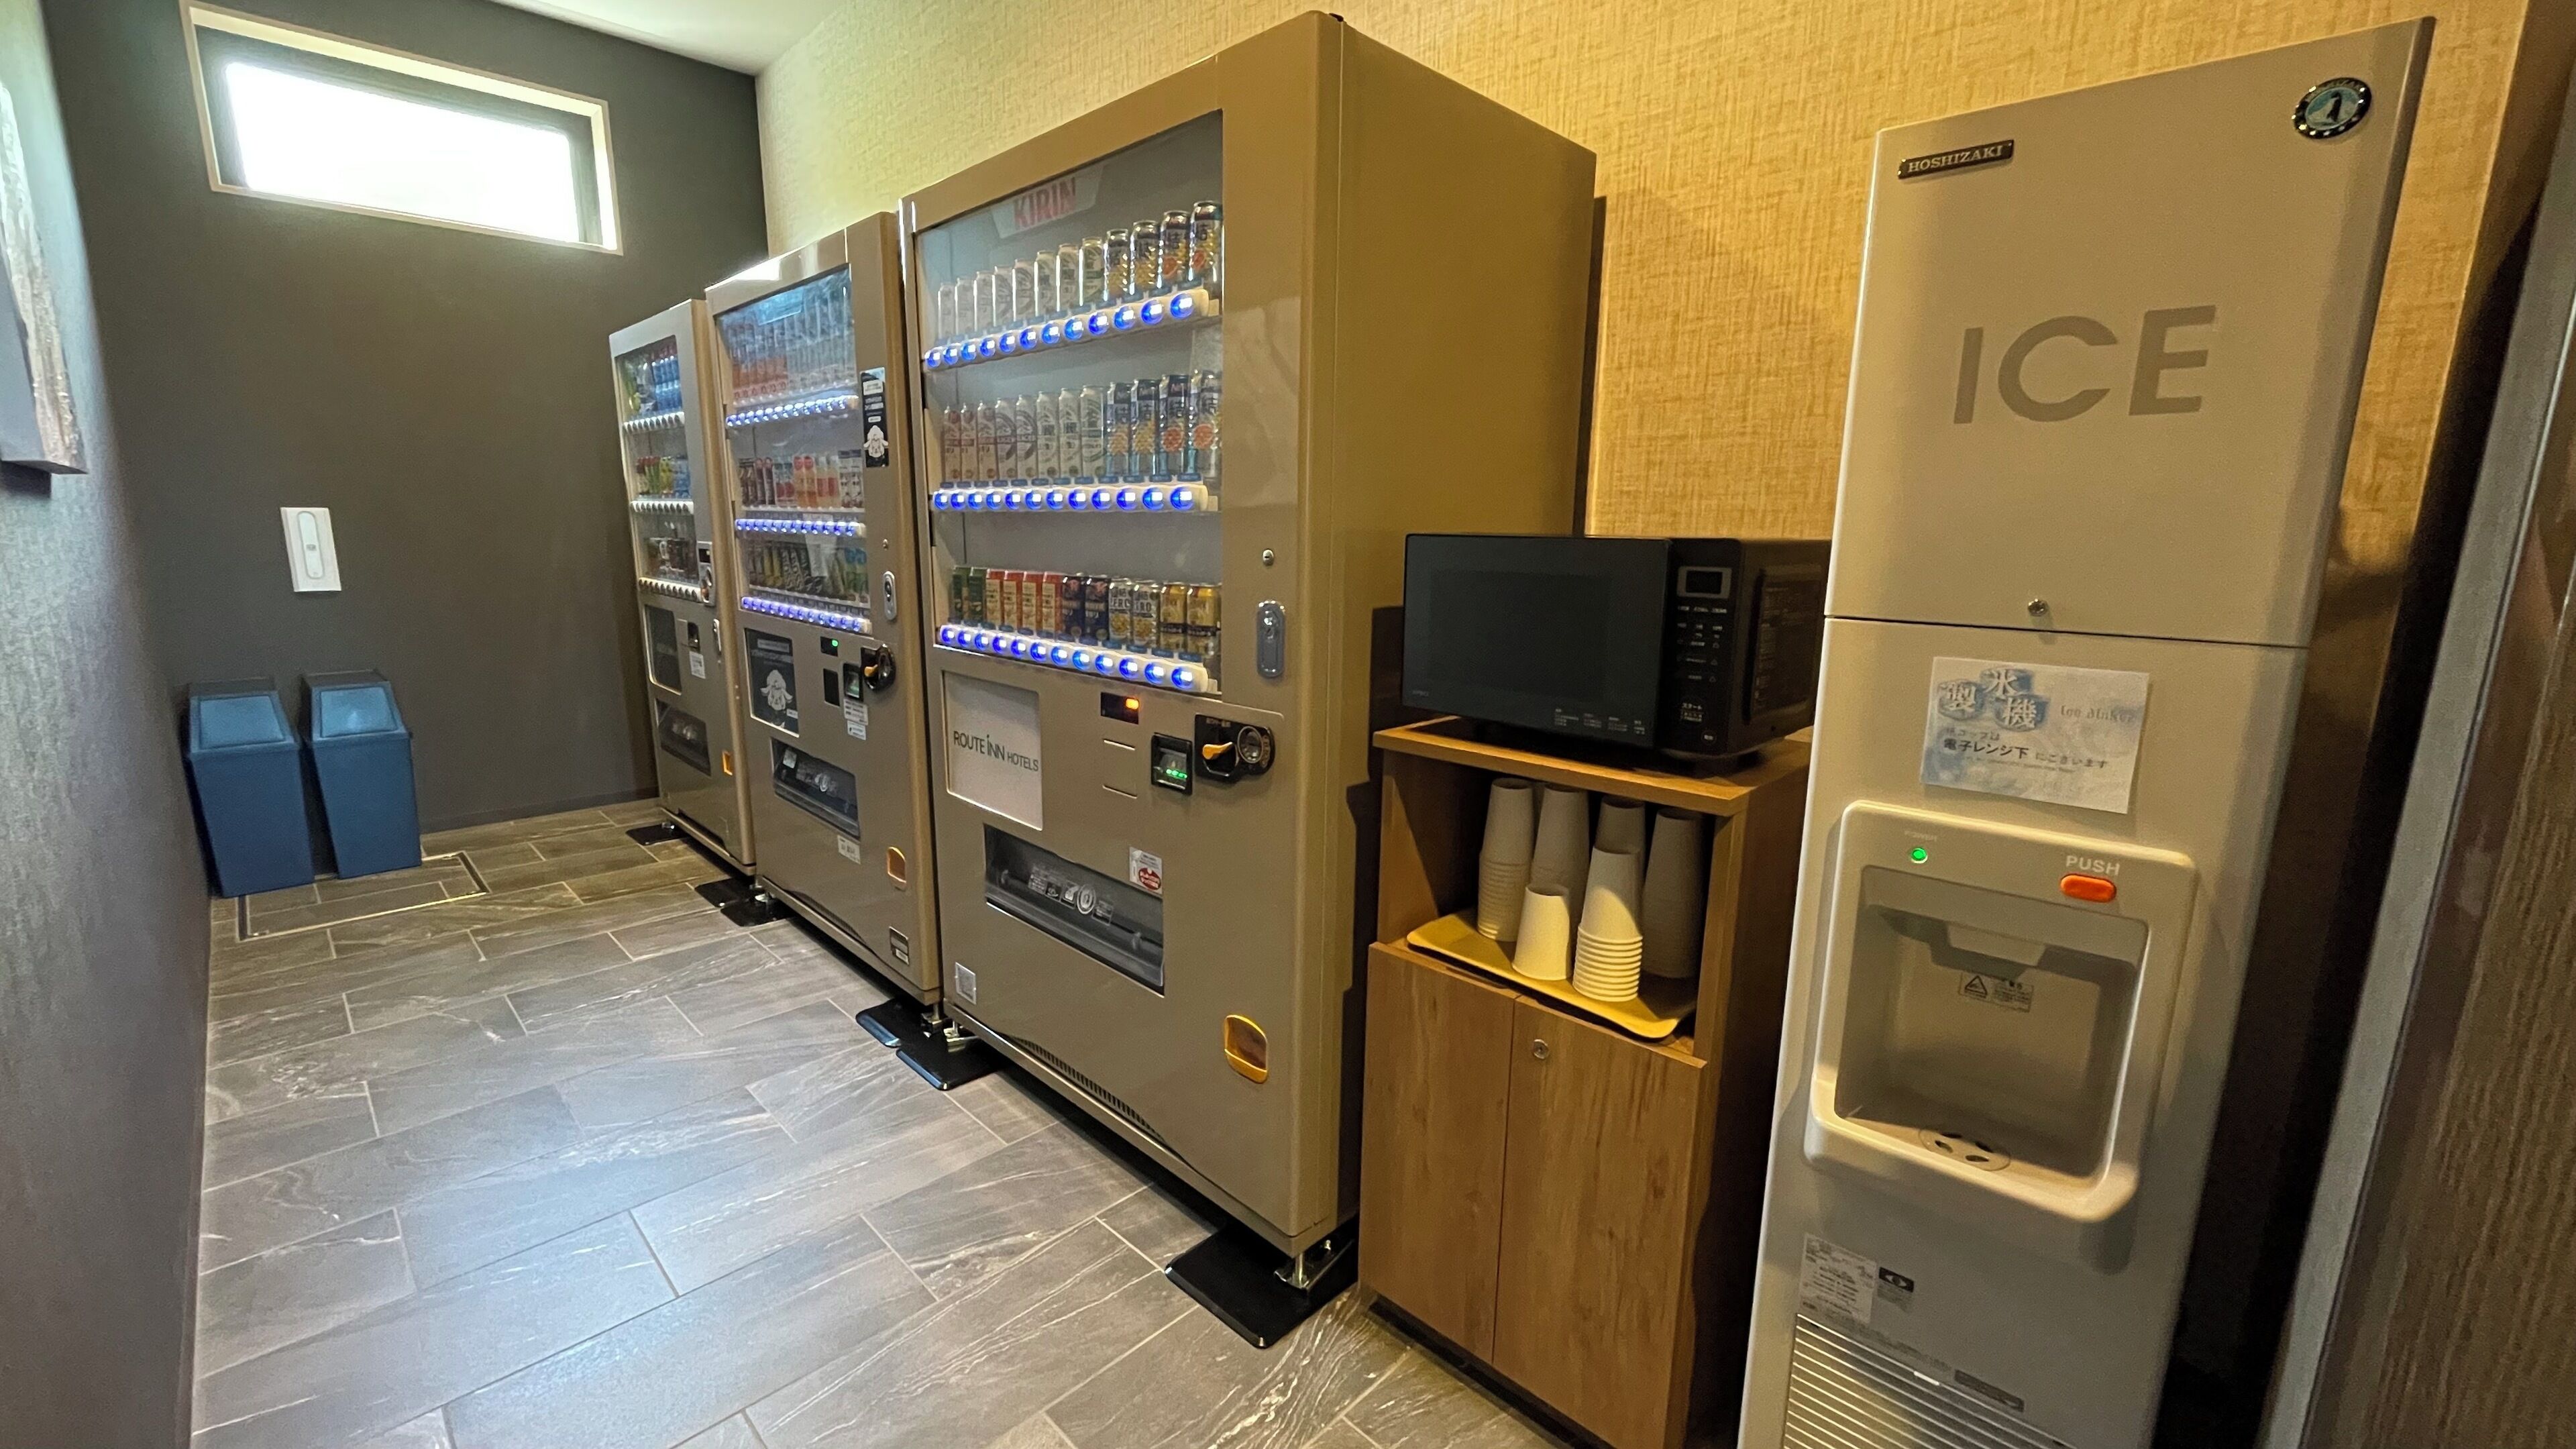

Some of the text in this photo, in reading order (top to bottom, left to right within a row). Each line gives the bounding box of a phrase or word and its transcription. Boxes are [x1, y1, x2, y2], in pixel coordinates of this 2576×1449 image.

[1908, 145, 2003, 173] HOSHIZAKI
[1014, 176, 1076, 229] KIRIN
[1953, 305, 2216, 424] ICE
[953, 731, 985, 755] ROUTE
[1007, 751, 1039, 772] HOTELS
[1943, 737, 2030, 759] 電子レンジ下
[2065, 855, 2120, 875] PUSH
